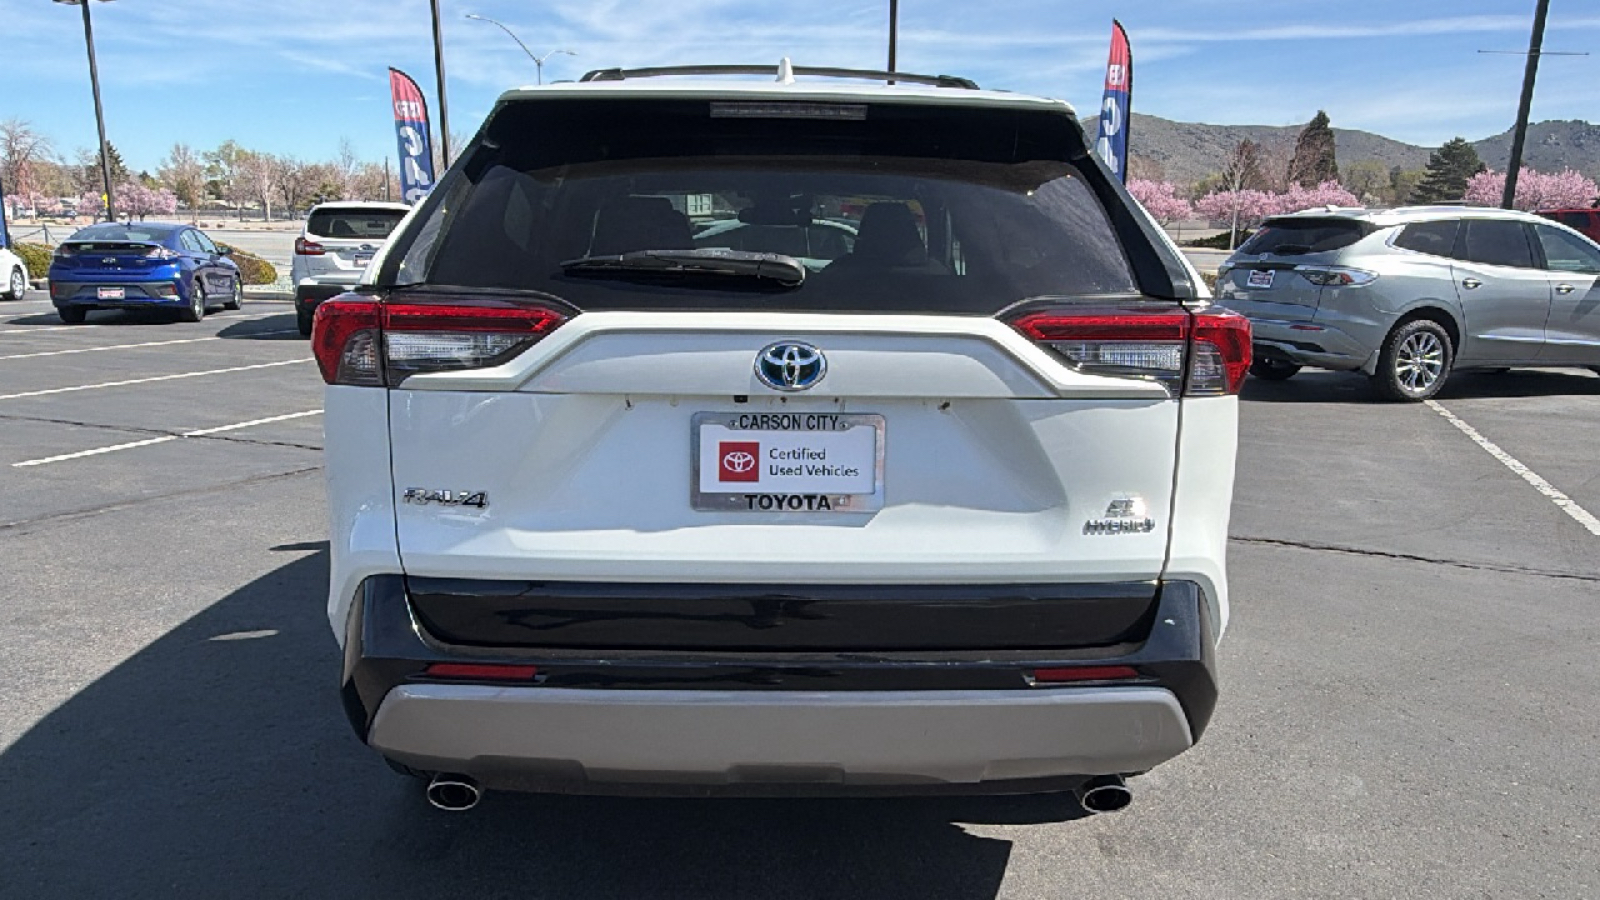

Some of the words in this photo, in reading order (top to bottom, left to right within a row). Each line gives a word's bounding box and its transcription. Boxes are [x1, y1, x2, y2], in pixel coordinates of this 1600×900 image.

[739, 415, 801, 430] CARSON
[806, 415, 839, 430] CITY
[769, 448, 826, 460] Certified
[769, 465, 802, 477] Used
[806, 465, 859, 477] Vehicles
[403, 488, 487, 508] RAV4
[744, 495, 831, 510] TOYOTA
[1082, 518, 1155, 535] HYBRID
